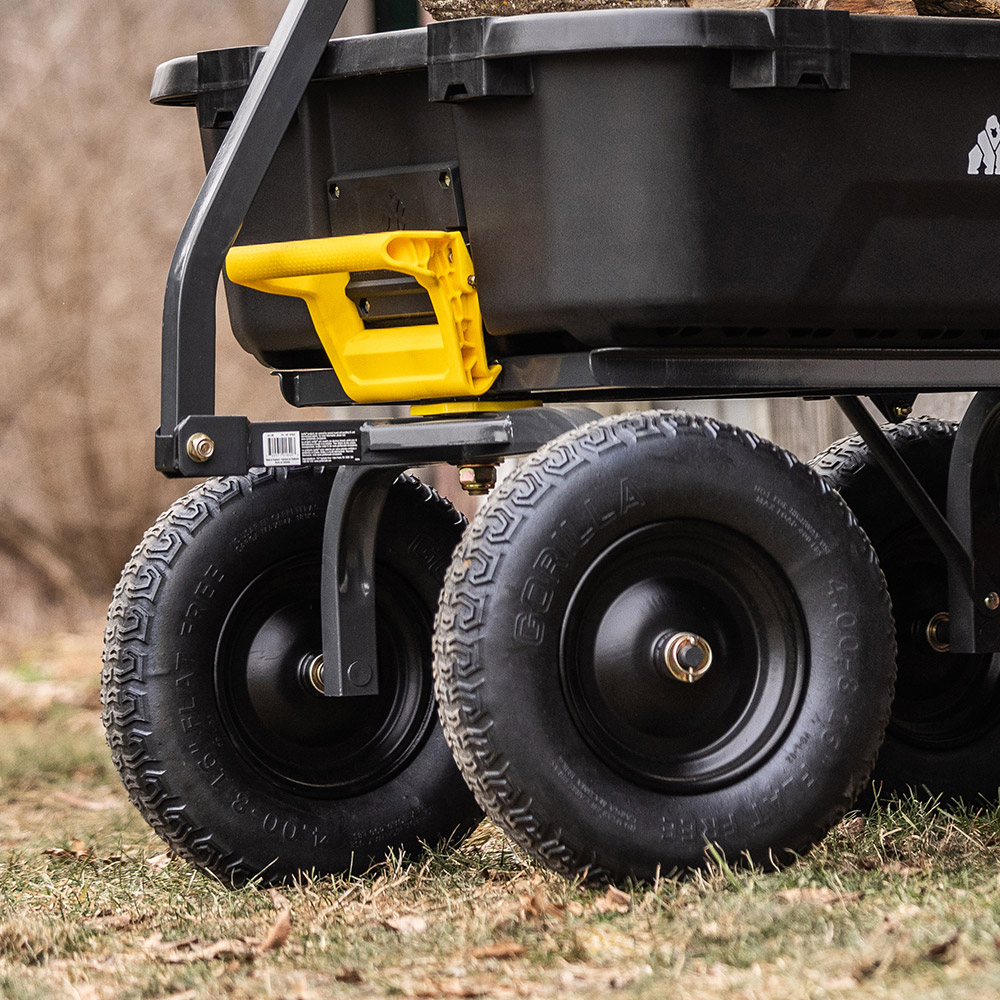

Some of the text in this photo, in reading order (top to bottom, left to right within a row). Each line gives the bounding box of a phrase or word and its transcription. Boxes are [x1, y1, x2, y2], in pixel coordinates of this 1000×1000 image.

[513, 477, 646, 646] GORILLA
[180, 564, 226, 638] FREE
[826, 576, 858, 696] 4.00-8
[176, 652, 201, 733] FLAT
[661, 808, 739, 848] FREE
[746, 764, 816, 832] FLAT
